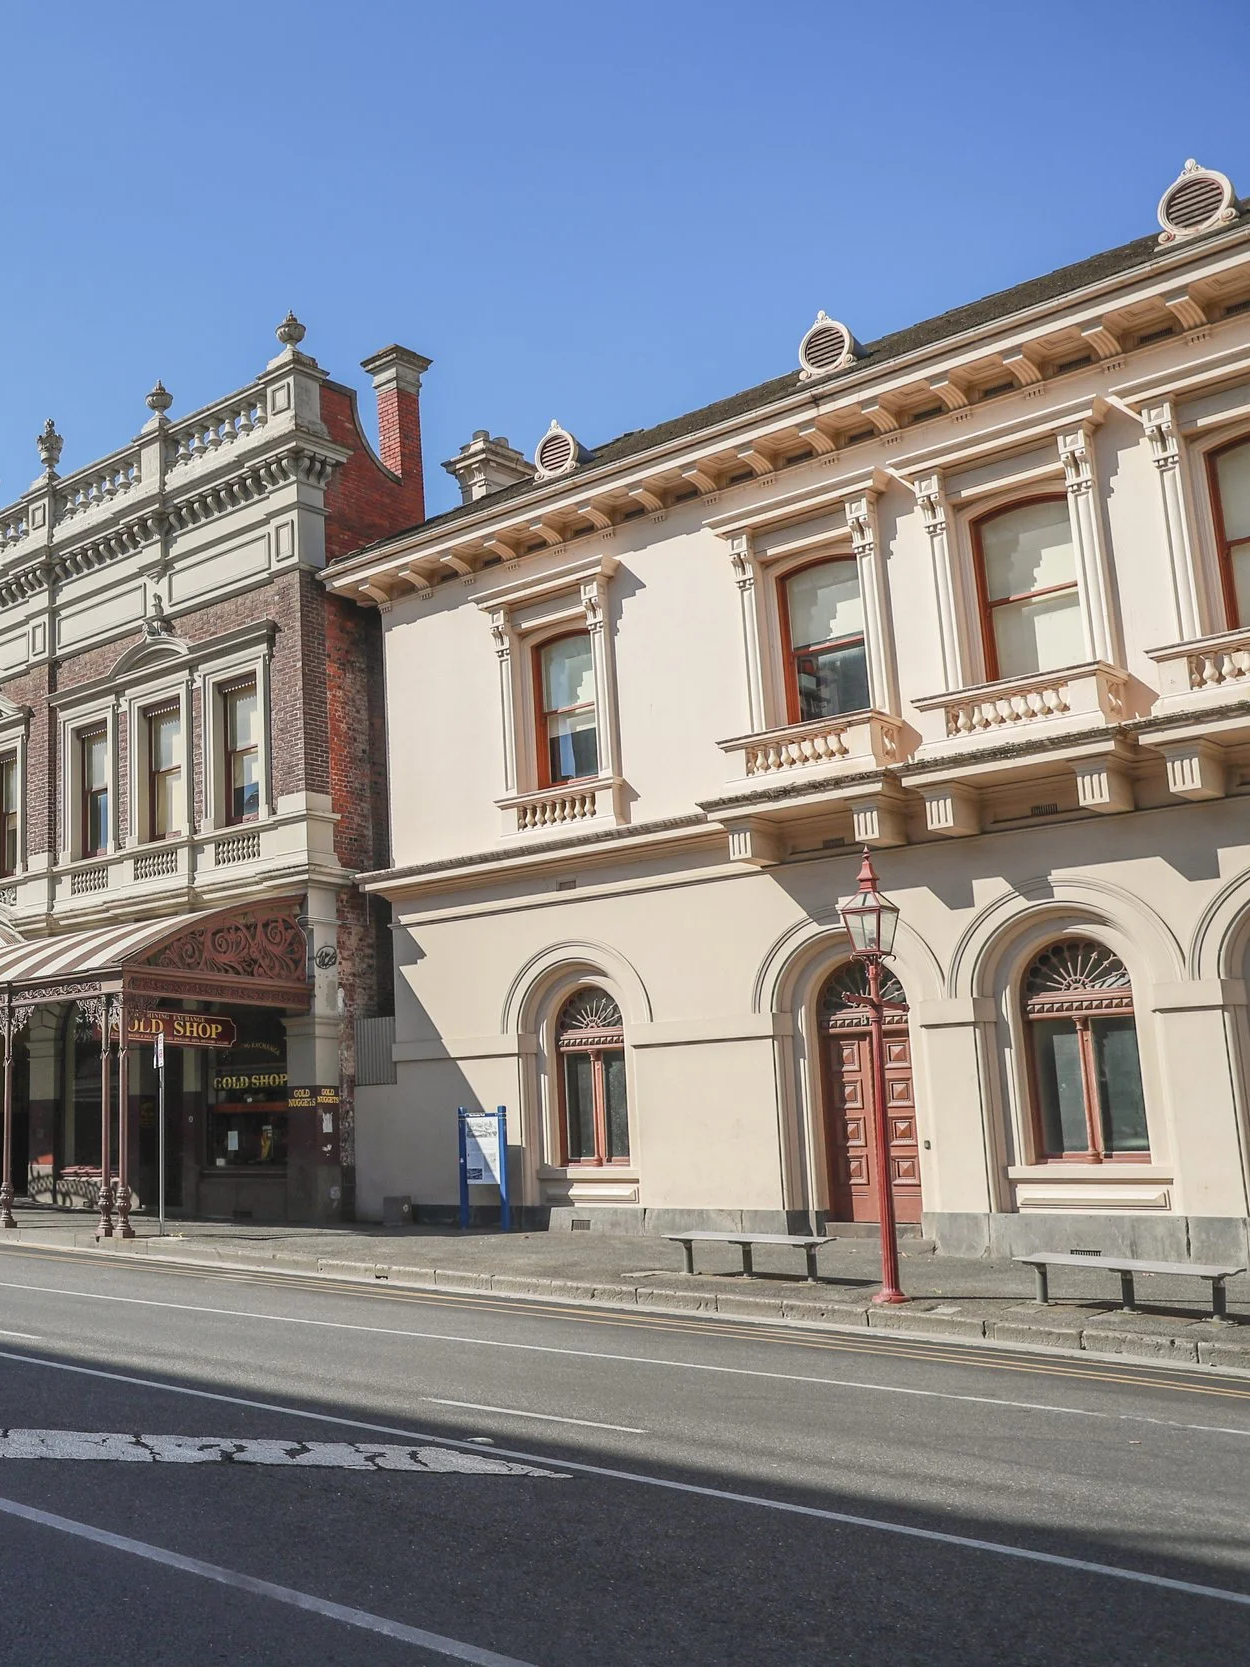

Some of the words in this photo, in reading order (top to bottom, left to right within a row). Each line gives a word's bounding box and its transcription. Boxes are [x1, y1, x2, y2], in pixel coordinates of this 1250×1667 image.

[173, 1020, 223, 1039] SHOP
[214, 1076, 249, 1089] GOLD
[251, 1073, 288, 1088] SHOP
[294, 1089, 311, 1098] GOLD
[321, 1088, 335, 1096] GOLD
[288, 1098, 317, 1107] NUGGETS
[317, 1096, 340, 1104] NUGGETS
